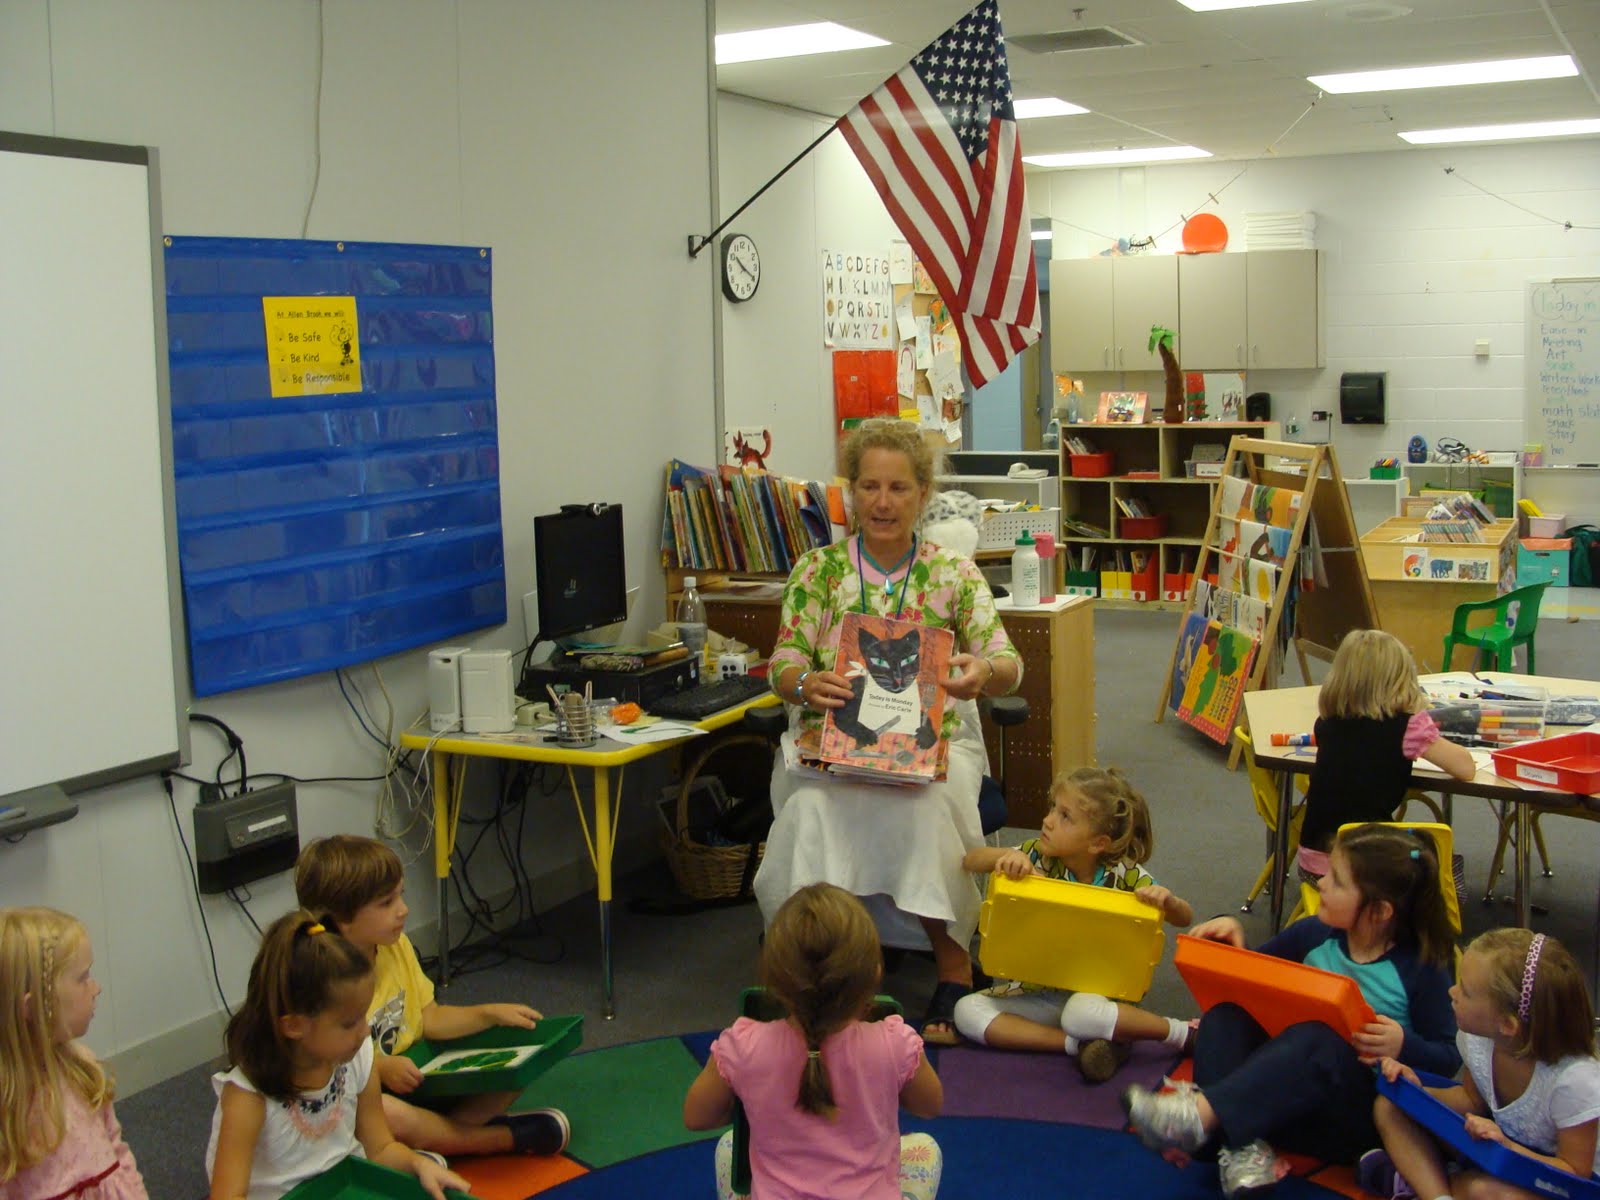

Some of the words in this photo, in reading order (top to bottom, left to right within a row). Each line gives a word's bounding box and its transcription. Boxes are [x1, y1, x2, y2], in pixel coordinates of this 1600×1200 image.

[288, 333, 298, 342] Be
[303, 332, 321, 342] Safe
[290, 354, 301, 363] Be
[304, 353, 320, 362] Kind
[1546, 348, 1566, 360] Art
[292, 374, 302, 384] Be
[306, 372, 350, 385] Responsible
[892, 698, 913, 706] Monday
